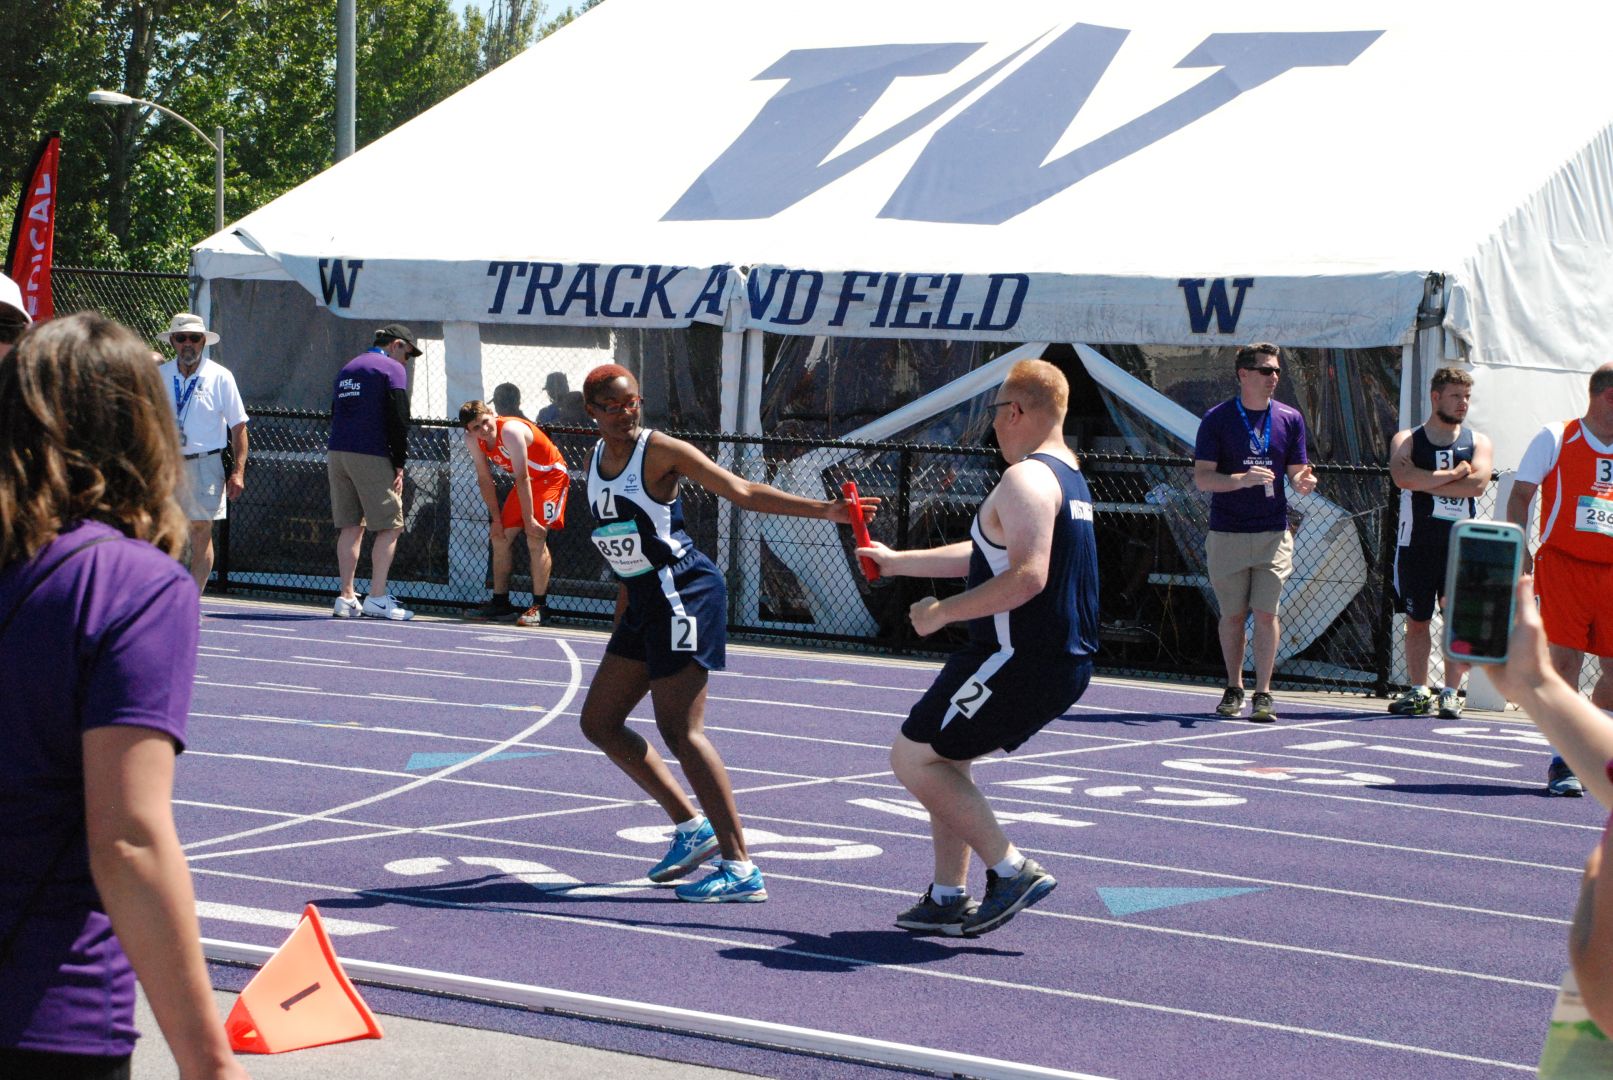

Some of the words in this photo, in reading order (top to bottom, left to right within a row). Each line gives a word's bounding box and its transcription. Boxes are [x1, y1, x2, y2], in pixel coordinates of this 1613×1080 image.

[658, 22, 1387, 225] W
[319, 259, 363, 308] W
[487, 261, 688, 319] TRACK
[828, 270, 1030, 331] FIELD
[1178, 278, 1254, 333] W
[1439, 451, 1450, 470] 3
[1600, 459, 1612, 482] 3
[546, 503, 554, 519] 3
[601, 487, 614, 517] 2
[597, 537, 635, 558] 859
[676, 618, 692, 649] 2
[955, 681, 984, 714] 2
[280, 982, 321, 1011] 1
